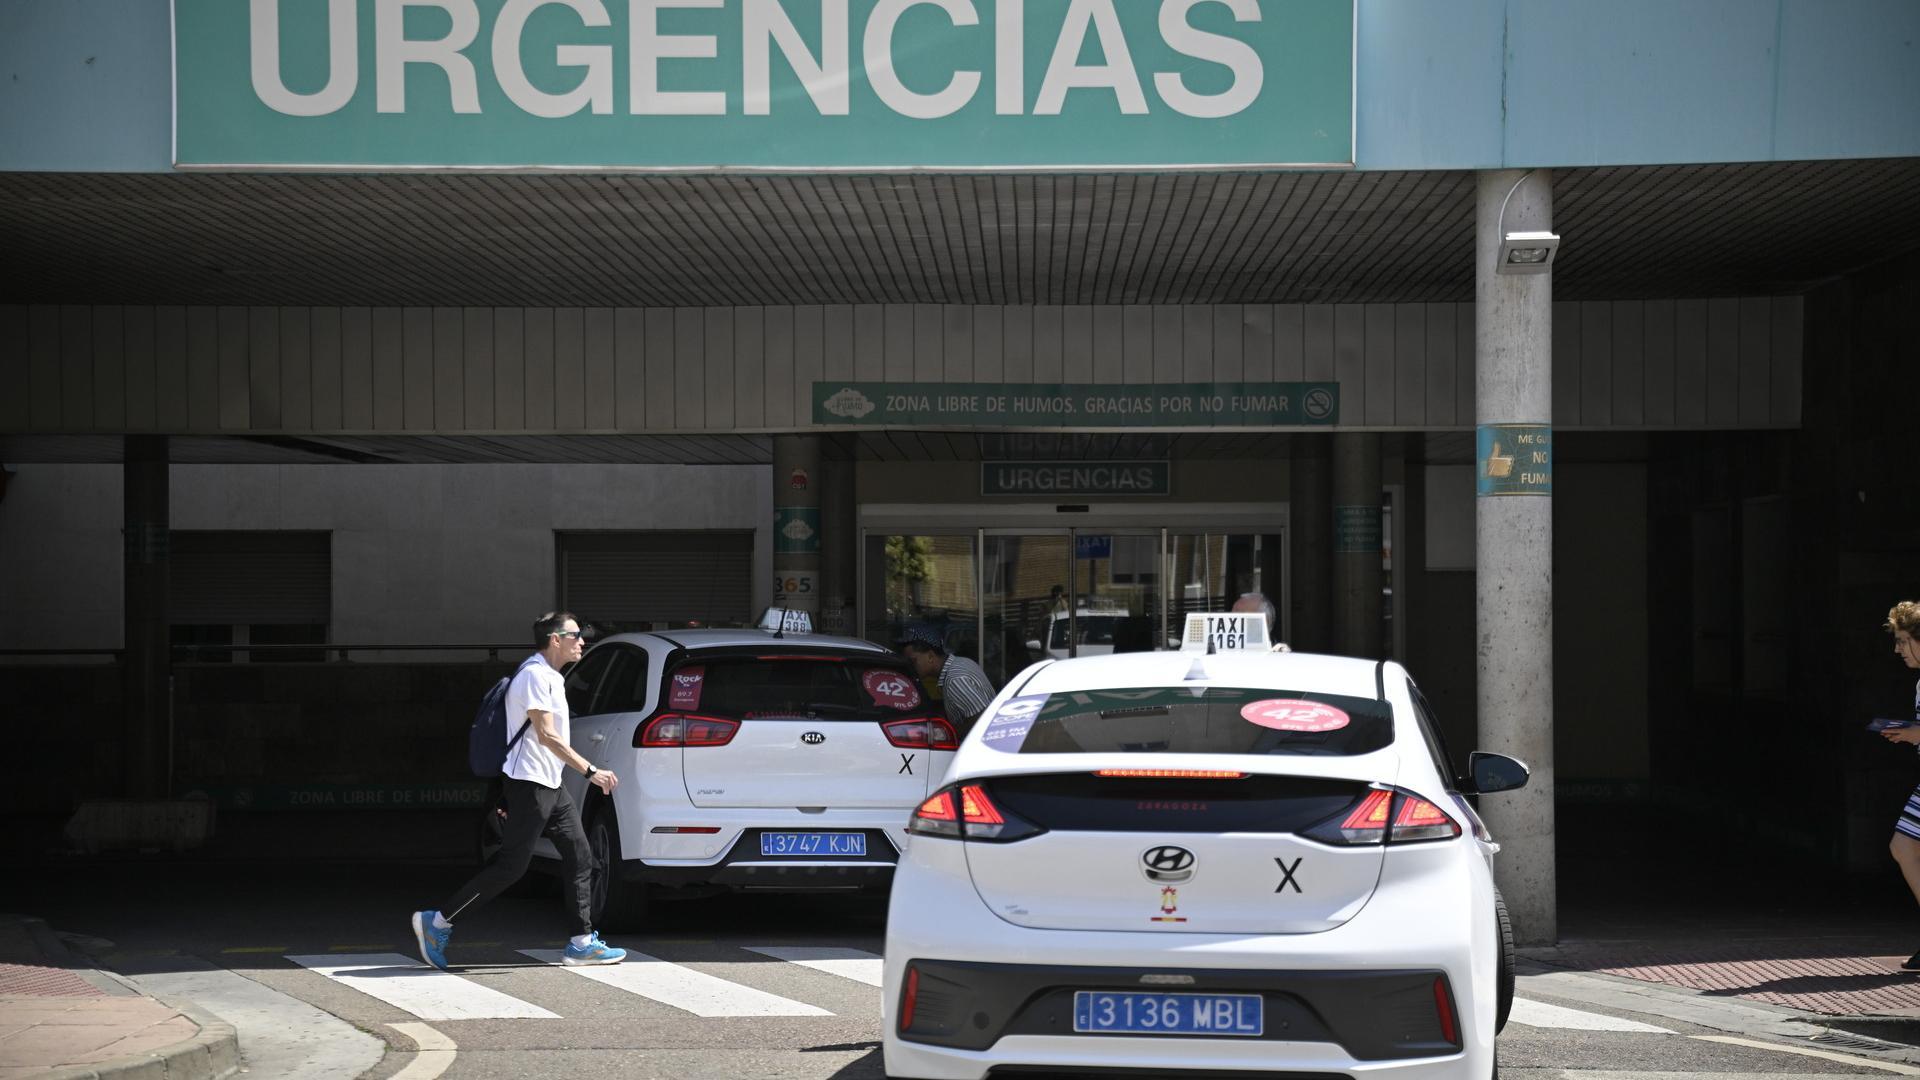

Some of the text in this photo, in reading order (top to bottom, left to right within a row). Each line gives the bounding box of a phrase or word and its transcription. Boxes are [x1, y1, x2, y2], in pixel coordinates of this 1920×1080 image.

[250, 0, 1264, 118] URGENCIAS
[886, 395, 1289, 413] ZONA LIBRE DE HUMOS. GRACIAS POR NO FUMAR
[1518, 434, 1534, 444] ME
[1532, 451, 1549, 463] NO
[998, 467, 1154, 490] URGENCIAS
[1207, 617, 1245, 633] TAXI
[876, 681, 906, 697] 42
[1261, 708, 1320, 722] 42
[805, 733, 822, 743] KIA
[899, 753, 915, 775] X
[289, 791, 335, 805] ZONA
[343, 790, 384, 804] LIBRE
[392, 790, 413, 803] DE
[776, 835, 821, 852] 3747
[829, 836, 861, 852] KJN
[1274, 857, 1303, 894] X
[1097, 997, 1180, 1027] 3136
[1193, 999, 1255, 1030] MBL
